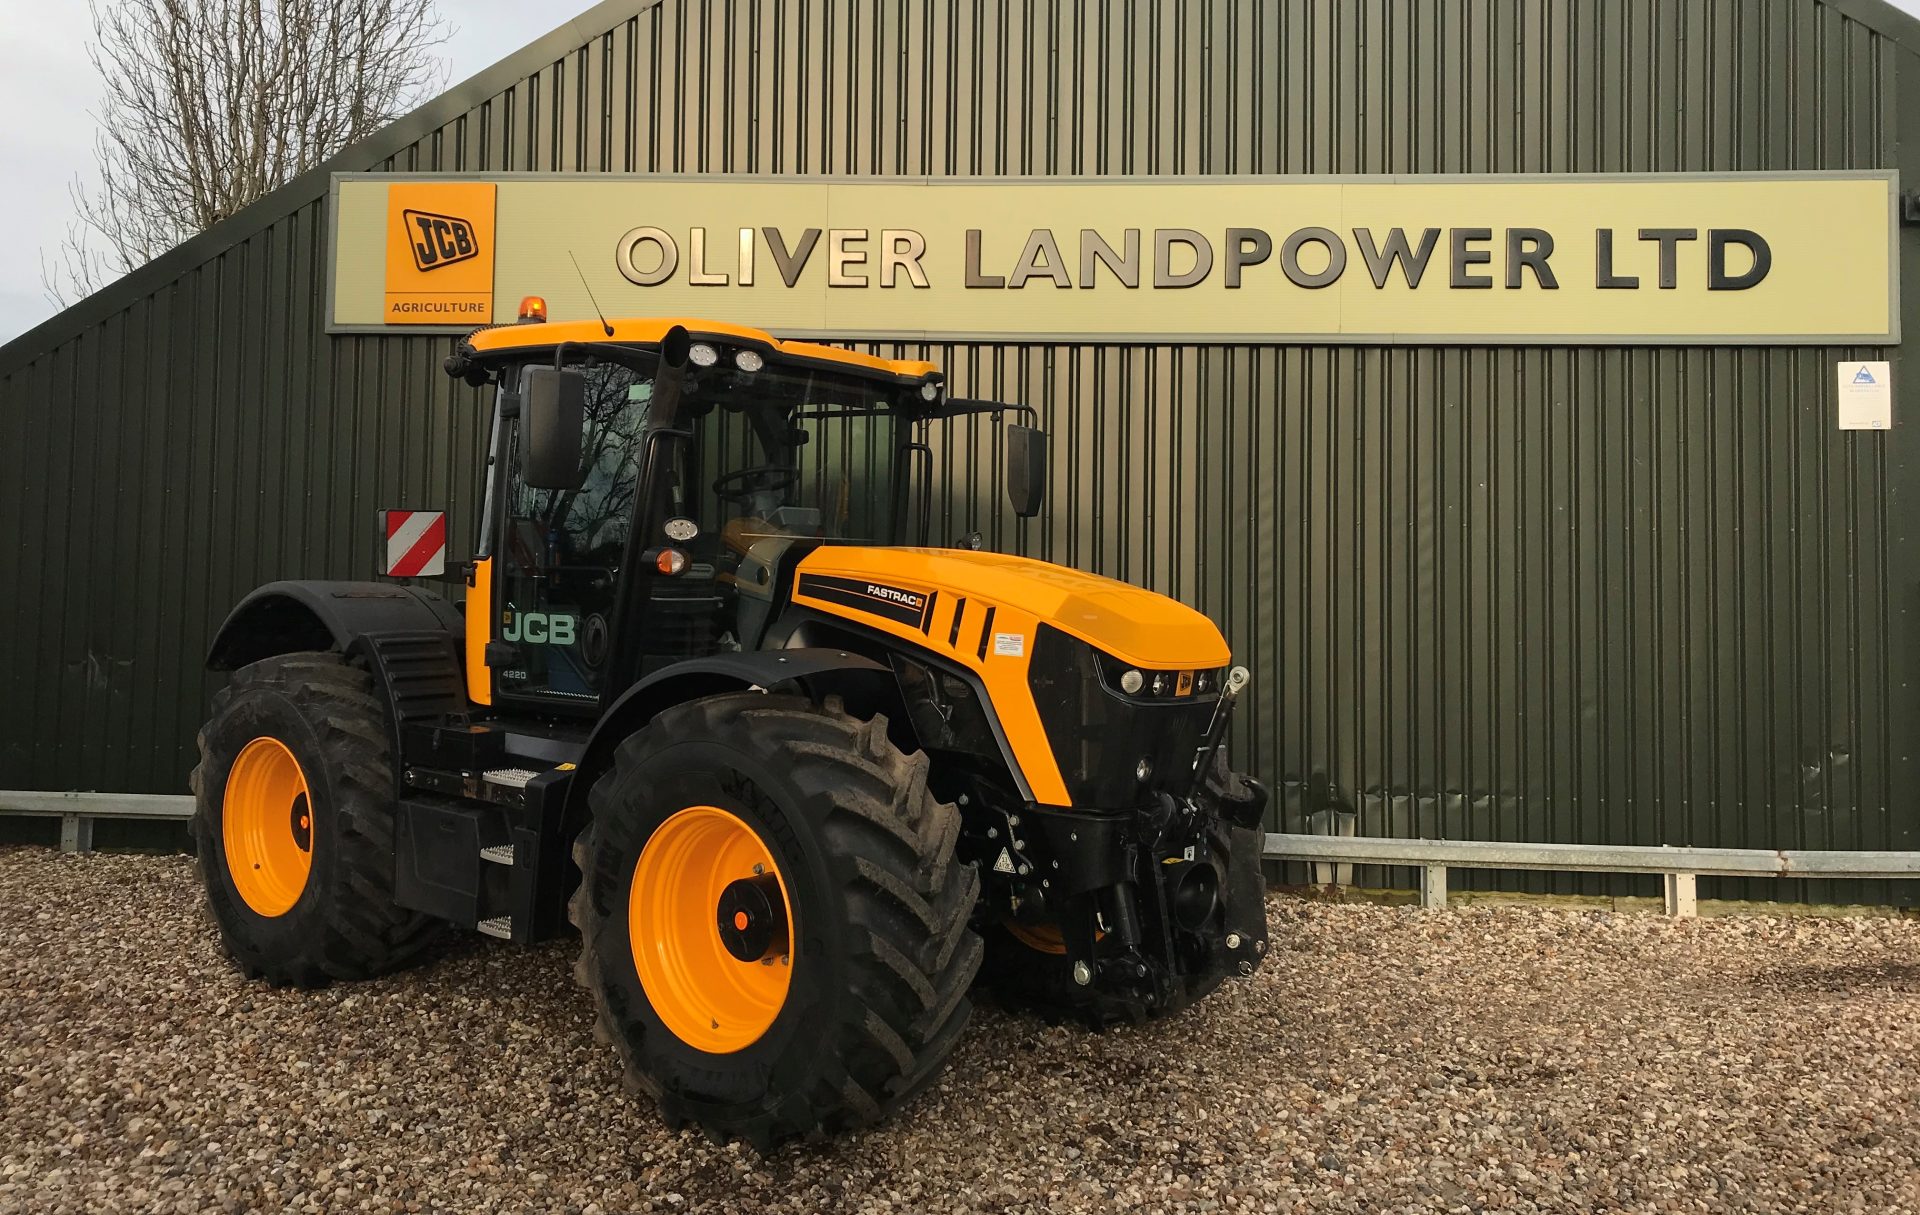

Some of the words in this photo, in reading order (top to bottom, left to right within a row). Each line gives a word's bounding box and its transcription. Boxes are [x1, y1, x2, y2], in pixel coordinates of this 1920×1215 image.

[415, 216, 472, 264] JCB
[616, 225, 931, 288] OLIVER
[965, 227, 1560, 290] LANDPOWER
[1596, 228, 1772, 290] LTD
[392, 302, 485, 313] AGRICULTURE
[503, 612, 575, 645] JCB
[502, 670, 527, 680] 4220
